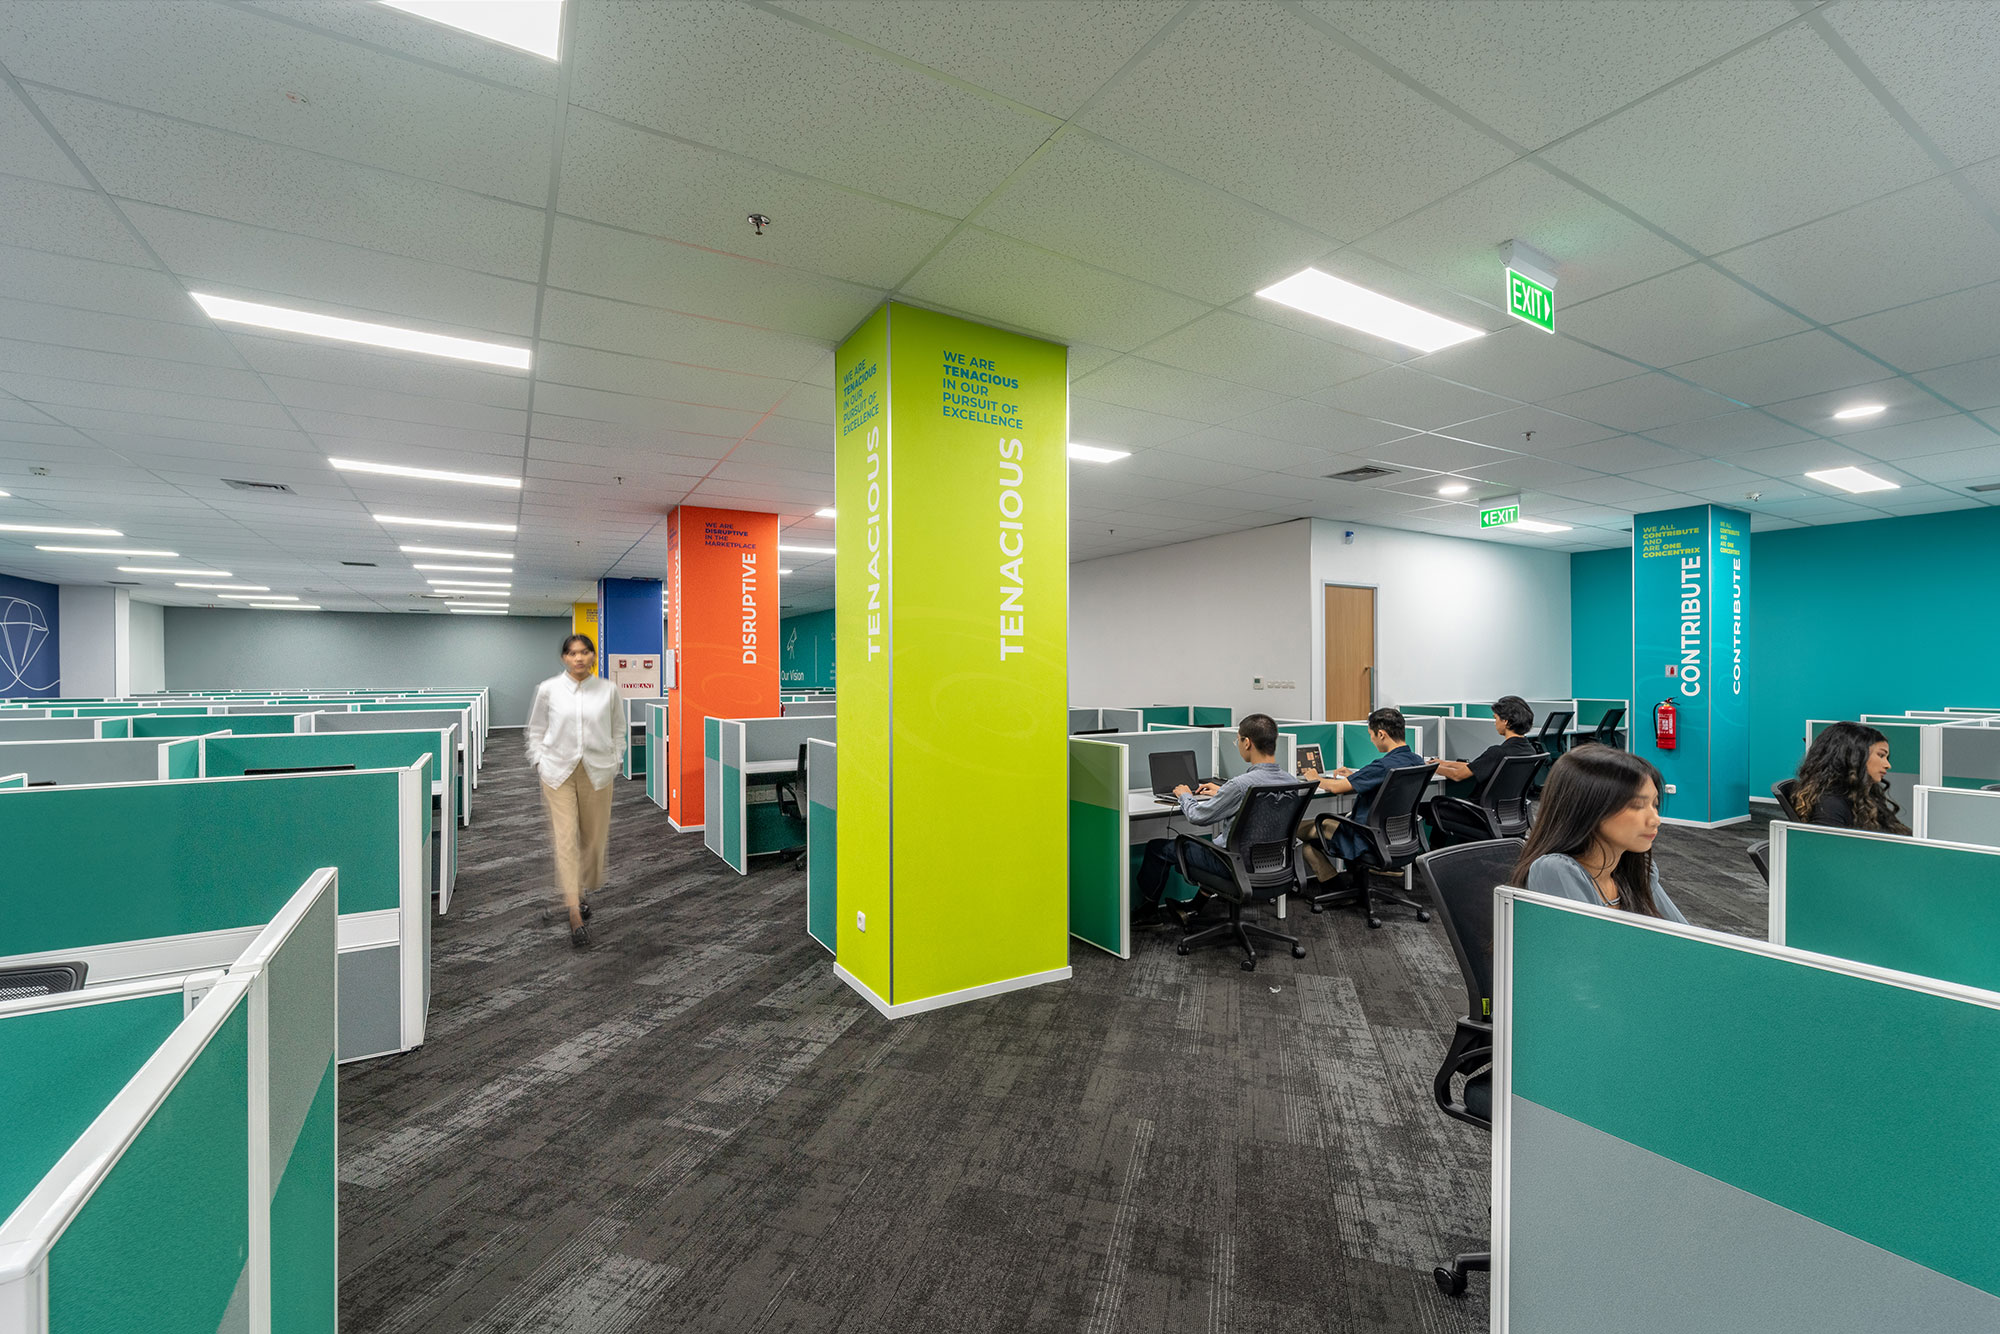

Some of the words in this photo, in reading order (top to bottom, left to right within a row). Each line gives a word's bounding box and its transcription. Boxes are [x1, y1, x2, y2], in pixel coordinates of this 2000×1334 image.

[1512, 277, 1543, 319] EXIT
[843, 369, 853, 385] WE
[854, 358, 866, 376] ARE
[943, 349, 966, 365] WE
[969, 356, 996, 372] ARE
[843, 363, 877, 398] TENACIOUS
[942, 364, 1019, 389] TENACIOUS
[943, 378, 956, 390] IN
[960, 381, 989, 397] OUR
[843, 398, 867, 424] PURSUIT
[868, 391, 877, 405] OF
[850, 388, 863, 405] OUR
[943, 391, 998, 411] PURSUIT
[1001, 403, 1019, 415] OF
[843, 403, 879, 437] EXCELLENCE
[943, 405, 1023, 430] EXCELLENCE
[1489, 508, 1516, 526] EXIT
[705, 528, 749, 537] DISRUPTIVE
[705, 540, 756, 549] MARKETPLACE
[867, 425, 881, 662] TENACIOUS
[1643, 527, 1699, 539] CONTRIBUTE
[1643, 538, 1662, 546] AND
[999, 437, 1024, 661] TENACIOUS
[1643, 547, 1700, 558] CONCENTRIX
[1662, 542, 1682, 550] ONE
[742, 552, 757, 665] DISRUPTIVE
[1681, 555, 1701, 697] CONTRIBUTE
[1733, 558, 1741, 695] CONTRIBUTE
[789, 668, 804, 681] Vision
